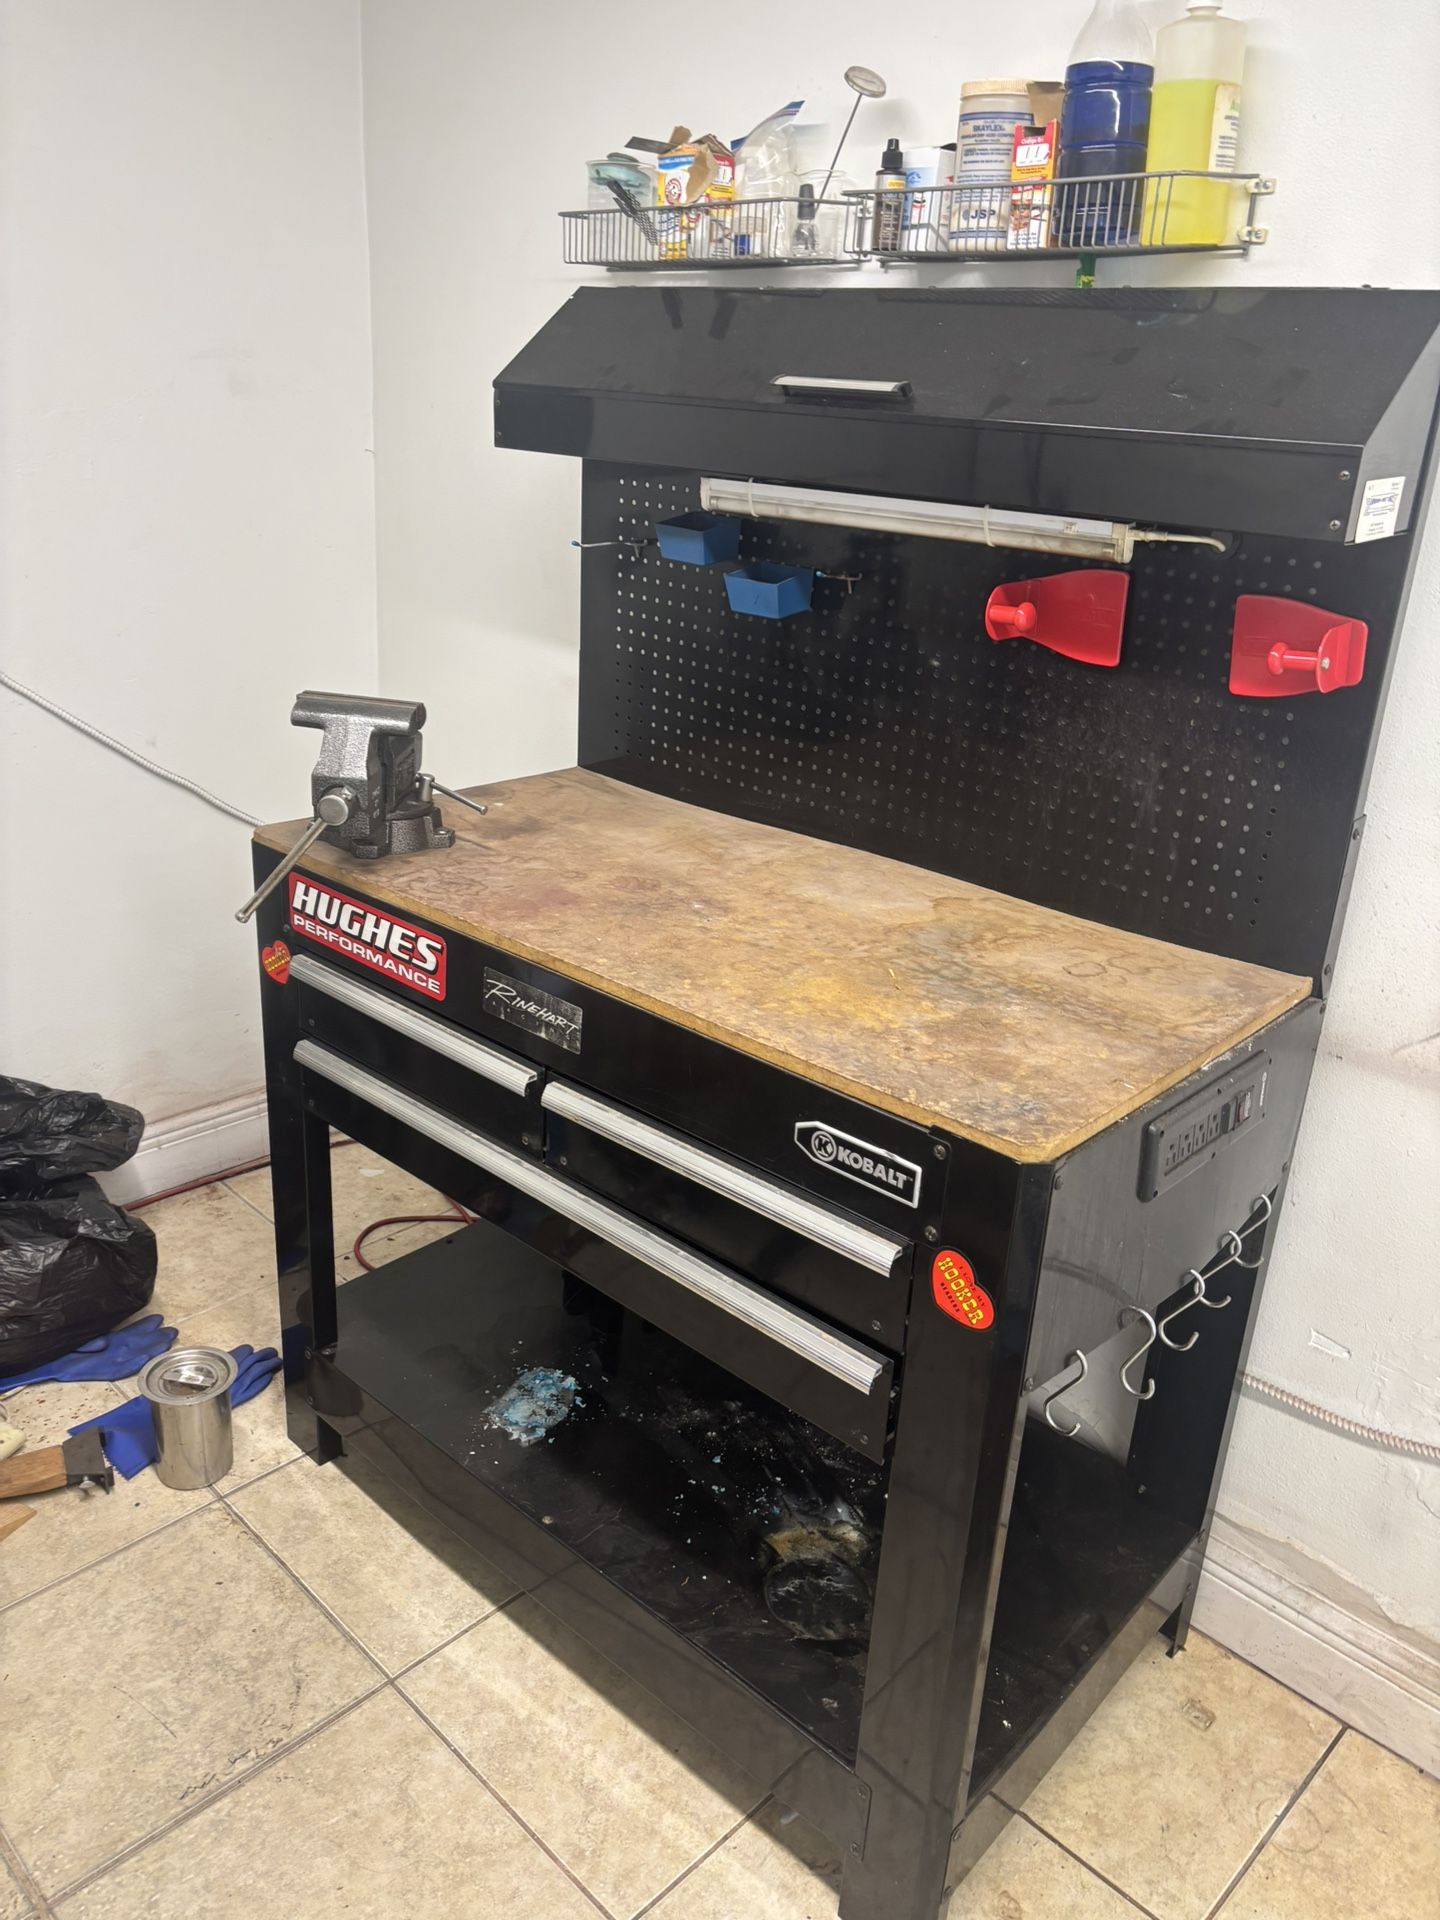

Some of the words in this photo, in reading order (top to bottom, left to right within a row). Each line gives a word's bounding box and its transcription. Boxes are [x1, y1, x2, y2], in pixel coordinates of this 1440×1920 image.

[970, 209, 996, 220] JSP
[292, 881, 443, 972] HUGHES
[293, 914, 441, 994] PERFORMANCE
[837, 1145, 907, 1190] KOBALT
[937, 1256, 984, 1325] HOOKER
